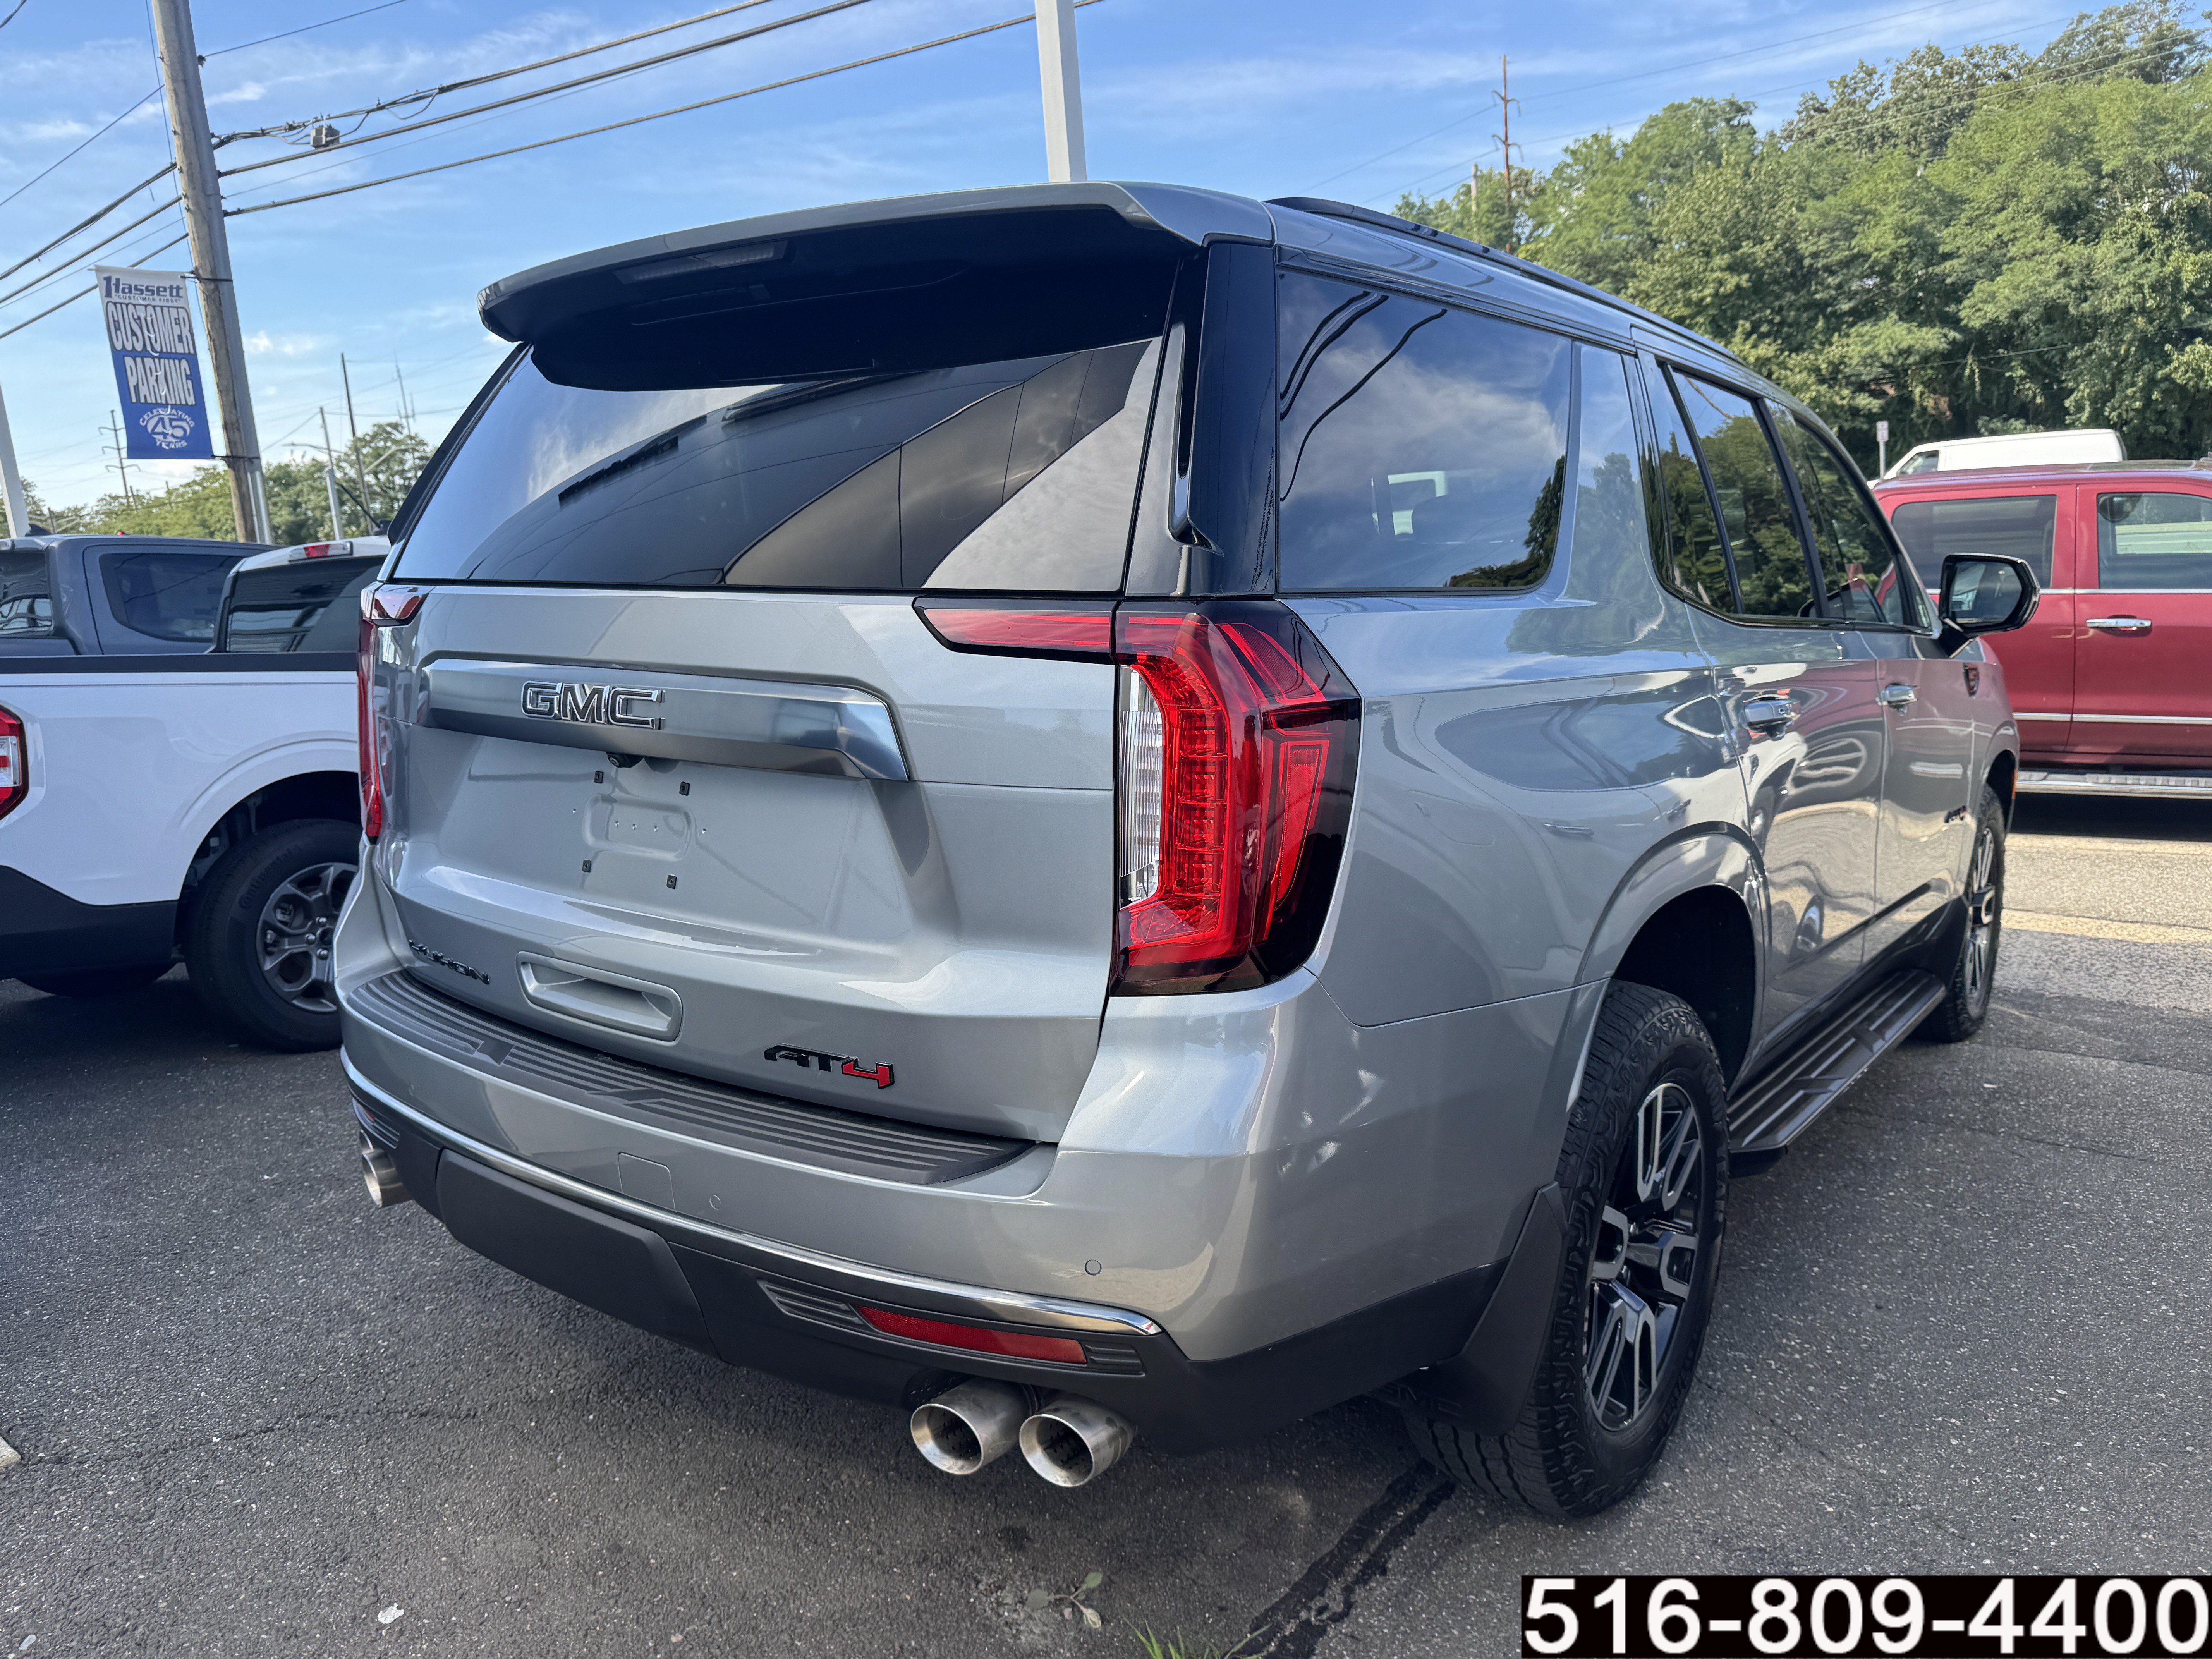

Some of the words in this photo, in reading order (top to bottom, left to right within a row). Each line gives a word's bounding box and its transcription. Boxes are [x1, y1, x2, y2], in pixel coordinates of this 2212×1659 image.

[103, 275, 183, 298] Hassett
[106, 301, 195, 354] CUSTOMER
[123, 356, 196, 405] PARKING
[147, 415, 190, 442] 45
[521, 680, 664, 729] GMC
[764, 1043, 895, 1089] AT4
